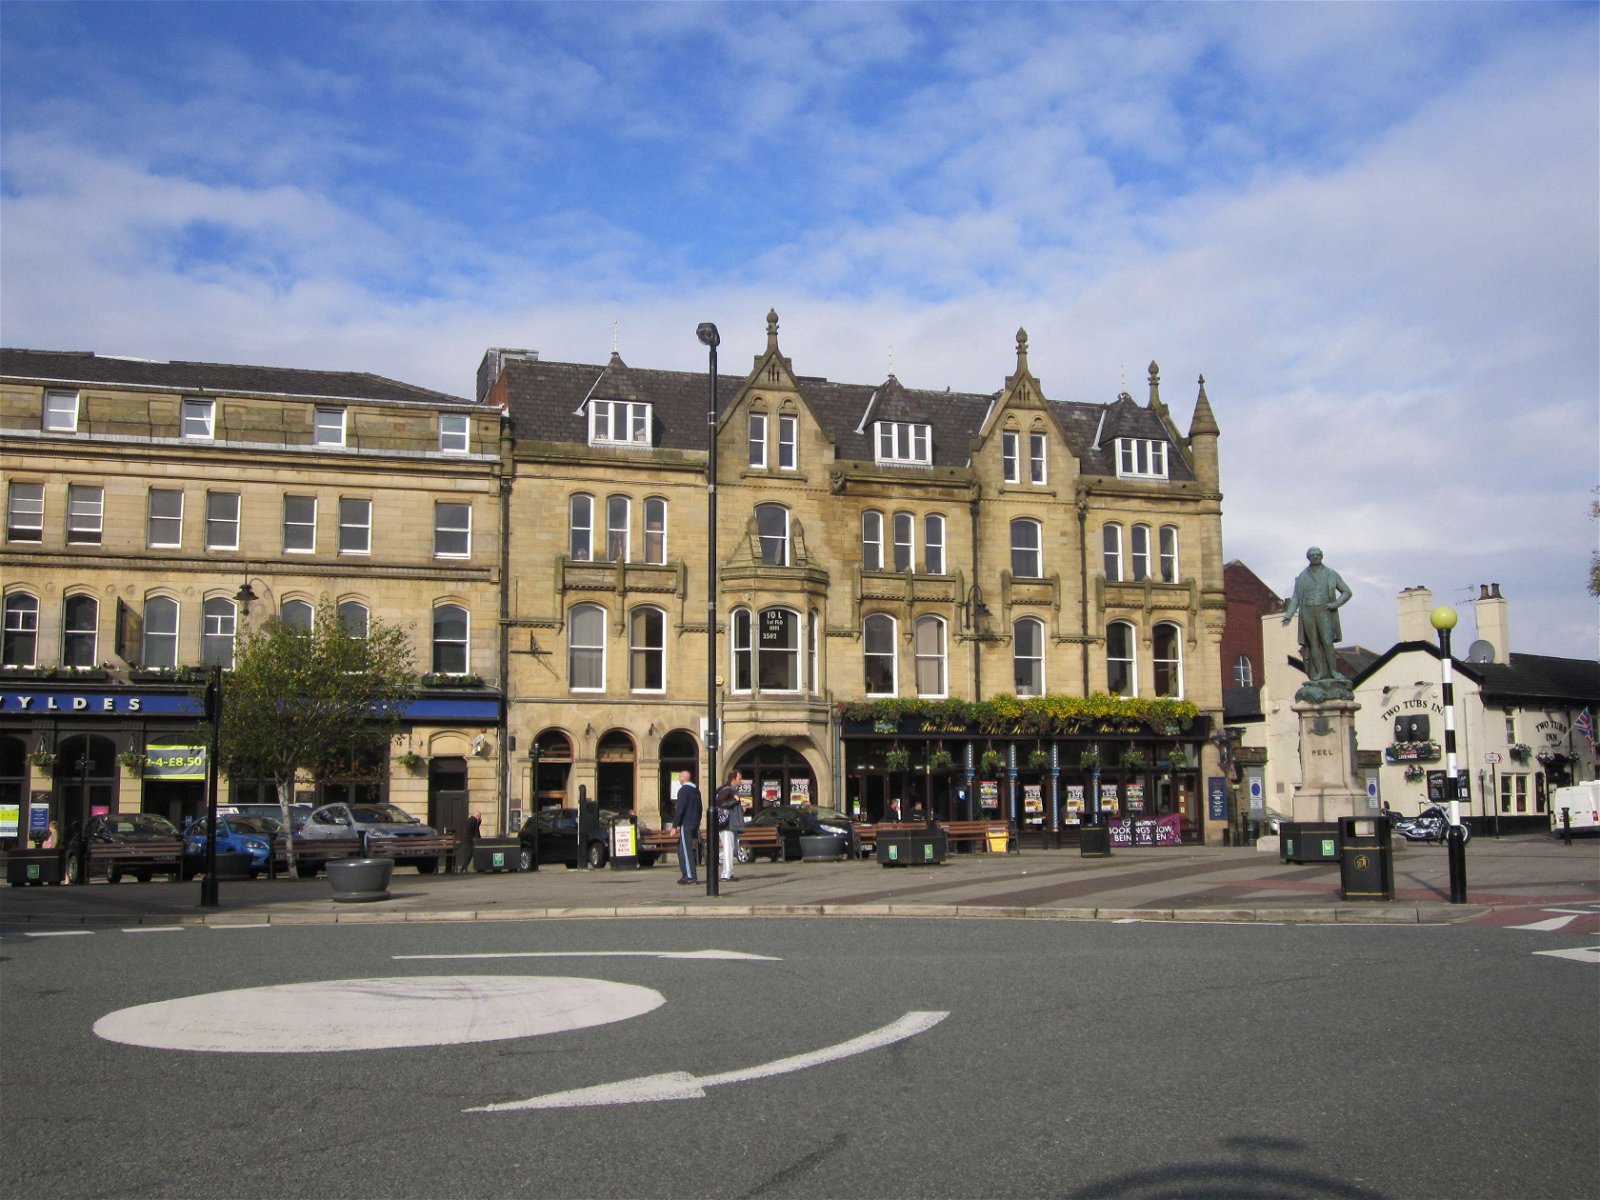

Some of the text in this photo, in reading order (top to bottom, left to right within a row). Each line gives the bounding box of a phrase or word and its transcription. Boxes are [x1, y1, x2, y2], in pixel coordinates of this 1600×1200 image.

[0, 696, 140, 710] YLDES
[1381, 699, 1445, 722] TWO TUBS IN
[1536, 720, 1567, 733] TWO TUBS
[1546, 733, 1557, 742] INN
[1142, 833, 1167, 842] TAEN
